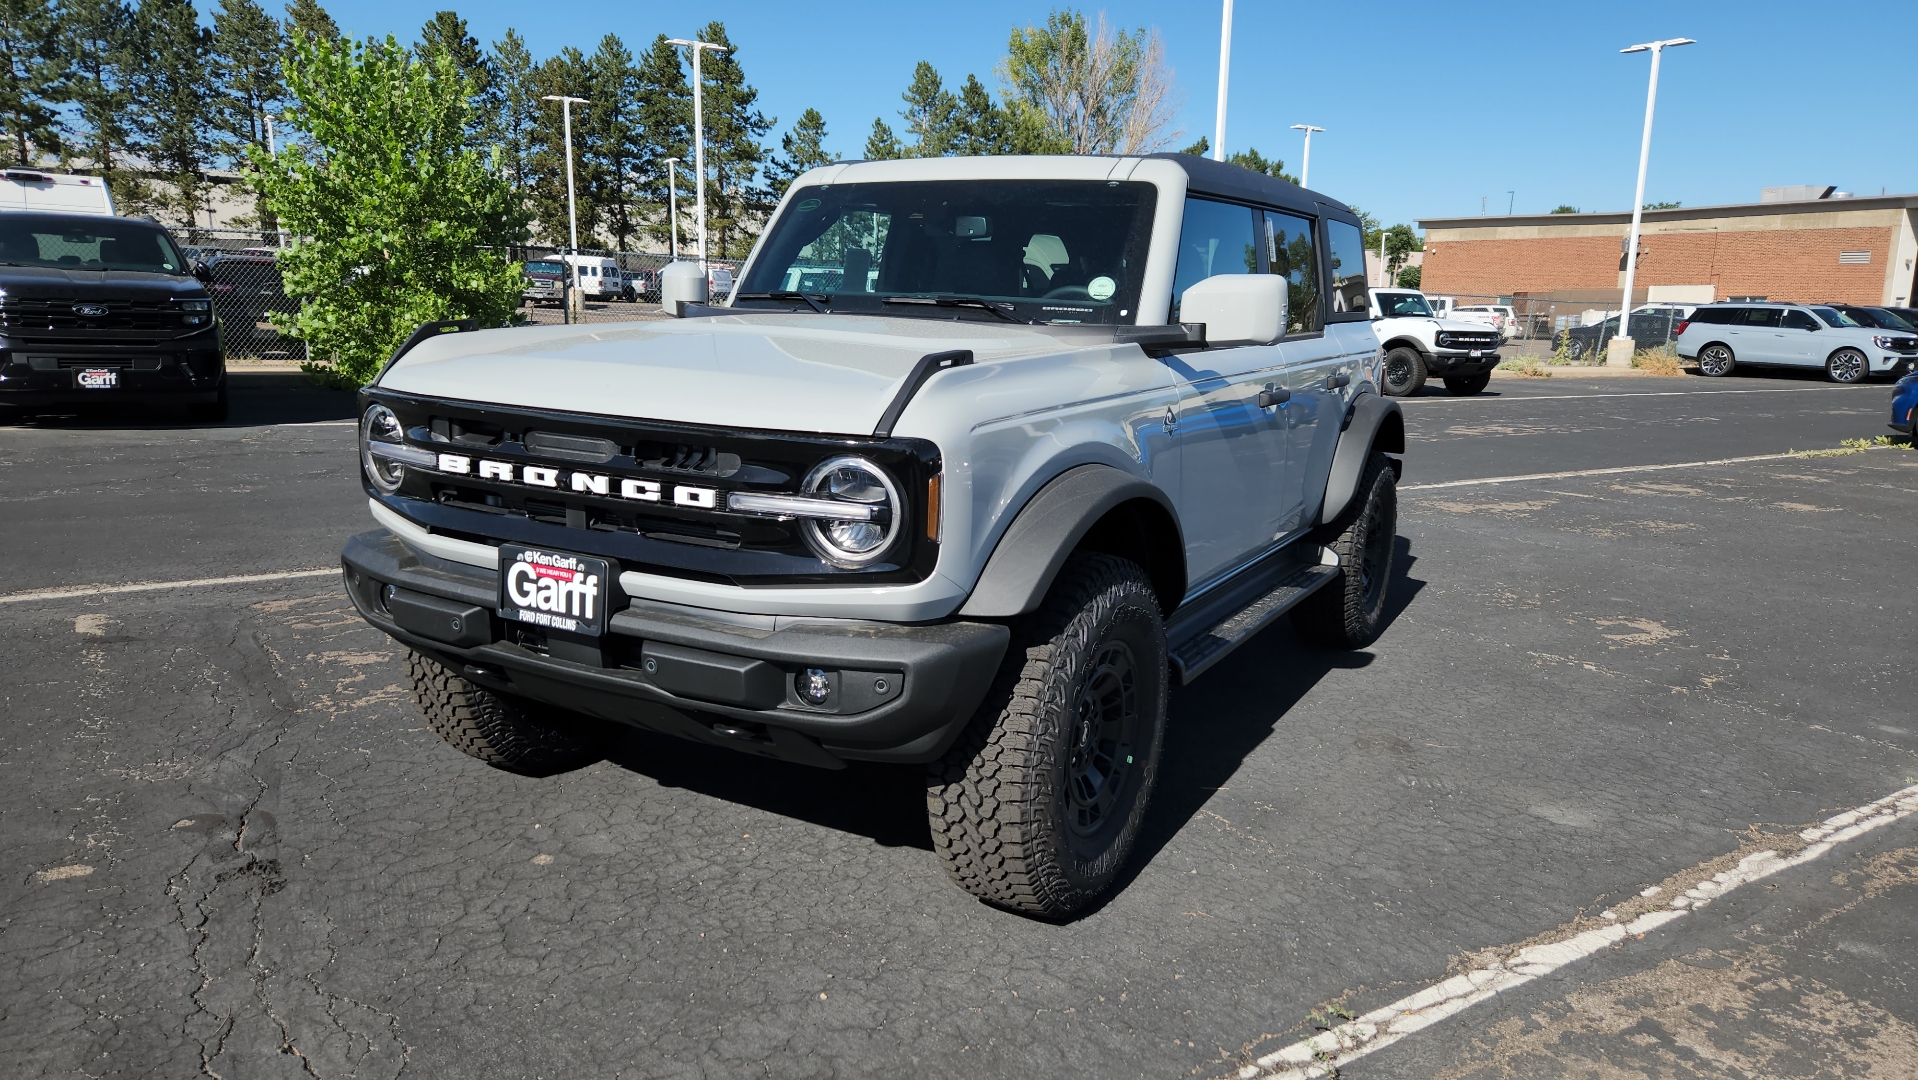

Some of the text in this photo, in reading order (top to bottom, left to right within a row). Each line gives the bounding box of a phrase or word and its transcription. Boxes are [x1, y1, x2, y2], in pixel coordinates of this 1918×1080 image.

[77, 372, 117, 385] Garff
[438, 453, 716, 509] BRONCO
[507, 561, 598, 619] Garff
[519, 609, 577, 631] FORD FORT COLLINS
